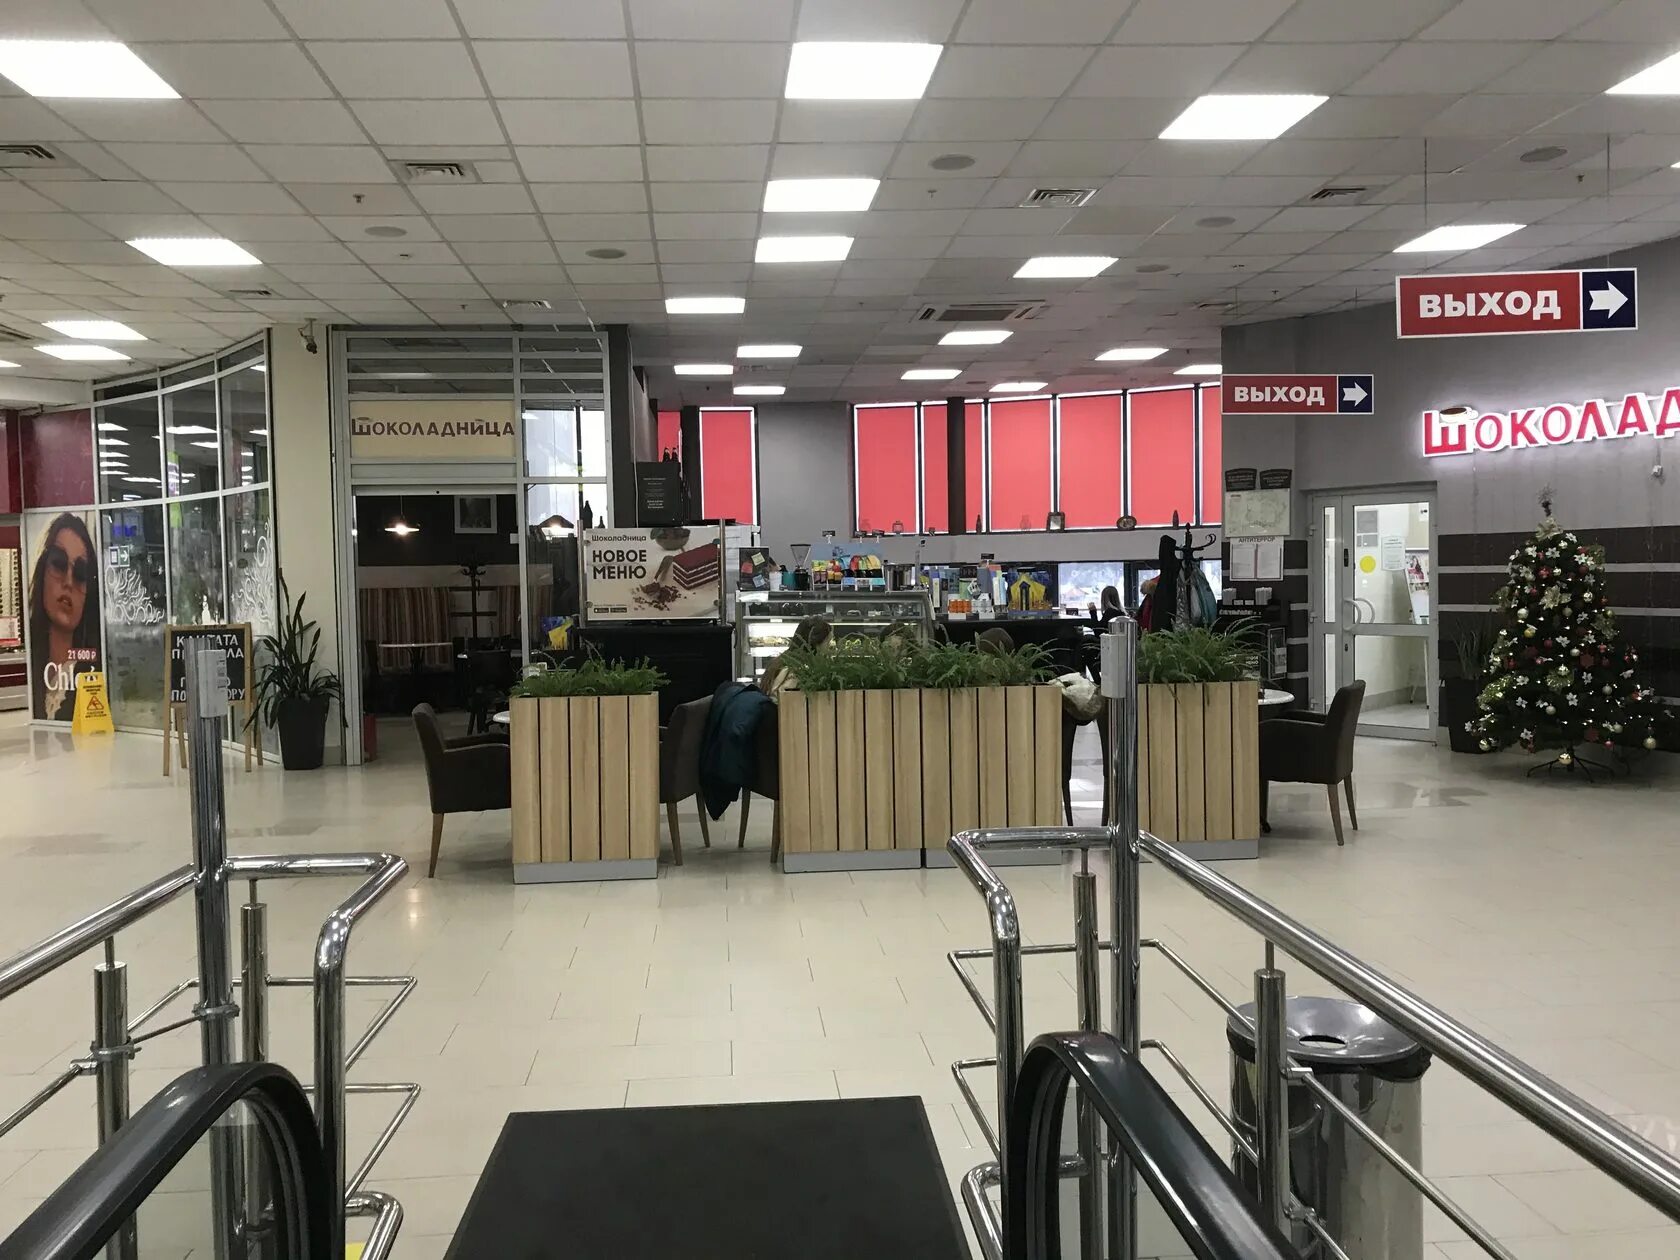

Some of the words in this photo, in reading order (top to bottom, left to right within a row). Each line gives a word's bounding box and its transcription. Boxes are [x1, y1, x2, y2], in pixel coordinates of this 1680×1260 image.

[1418, 289, 1562, 321] ВЫХОД
[1234, 386, 1326, 406] ВЫХОД
[351, 417, 515, 437] ШОКОЛАДНИЦА
[592, 534, 647, 542] Шоколадница
[592, 550, 647, 562] НОВОЕ
[593, 565, 647, 579] МЕНЮ
[67, 650, 76, 660] 21
[77, 650, 91, 660] 600
